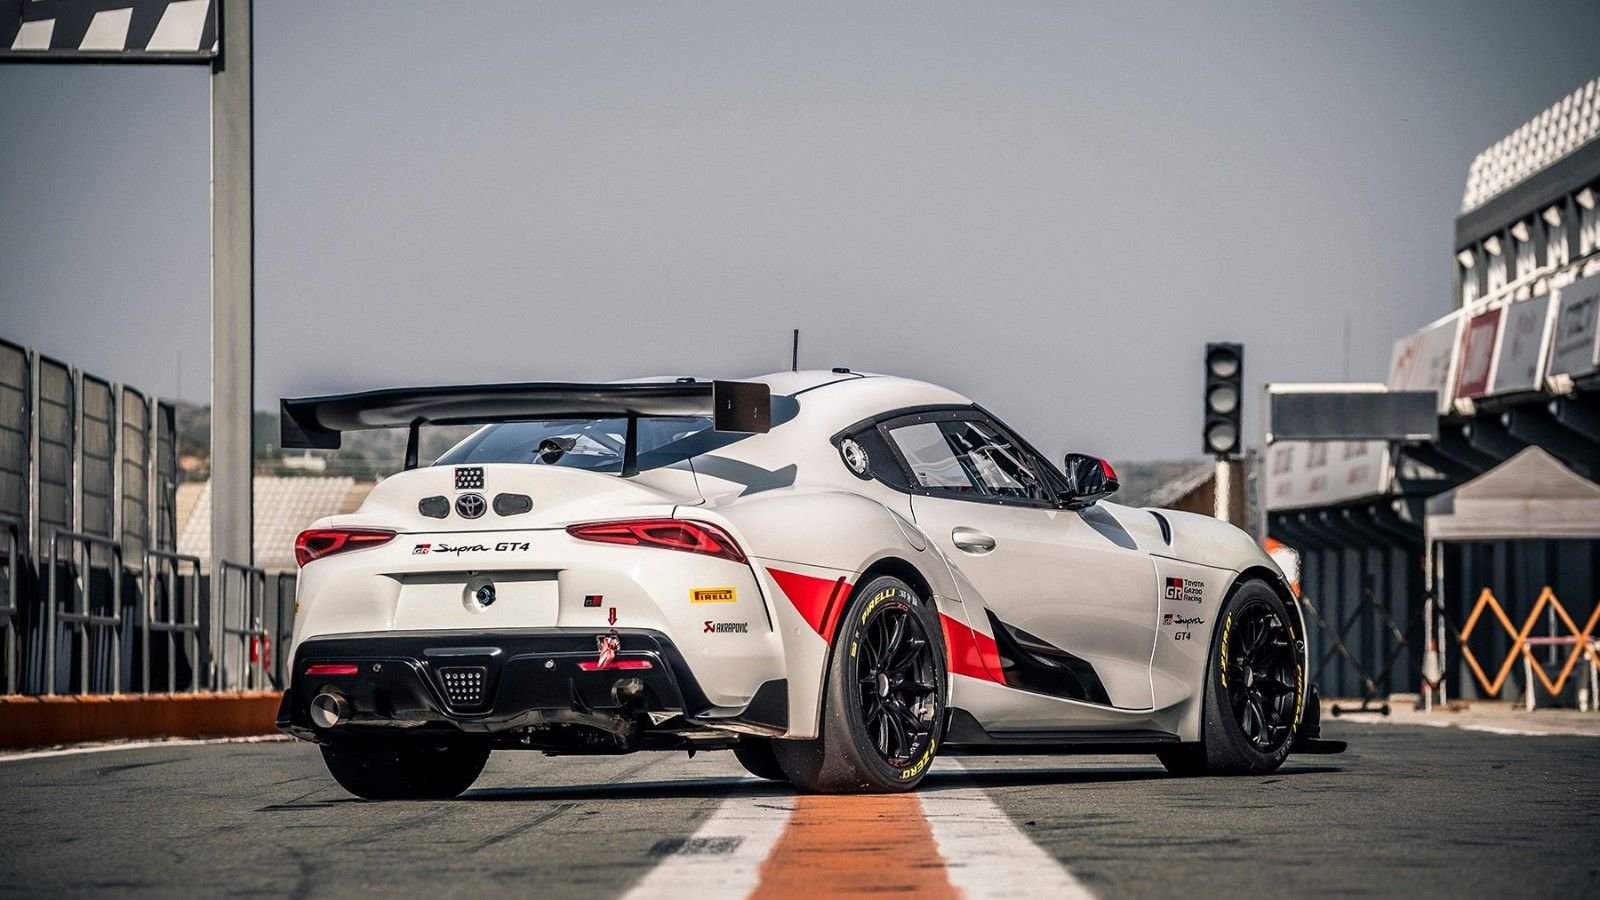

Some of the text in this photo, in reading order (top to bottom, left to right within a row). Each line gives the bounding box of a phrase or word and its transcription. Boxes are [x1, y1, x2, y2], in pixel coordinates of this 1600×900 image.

[432, 543, 492, 557] Supra
[495, 542, 530, 552] GT4
[1184, 579, 1205, 588] TOYOTA
[694, 590, 732, 600] PIRELLI
[1165, 586, 1183, 600] GR
[1183, 587, 1203, 595] GAZOO
[1184, 594, 1203, 604] Racing
[861, 588, 896, 626] PIRELLI
[1174, 614, 1205, 630] Supra
[1175, 632, 1191, 640] GT4
[902, 750, 930, 779] ZERO
